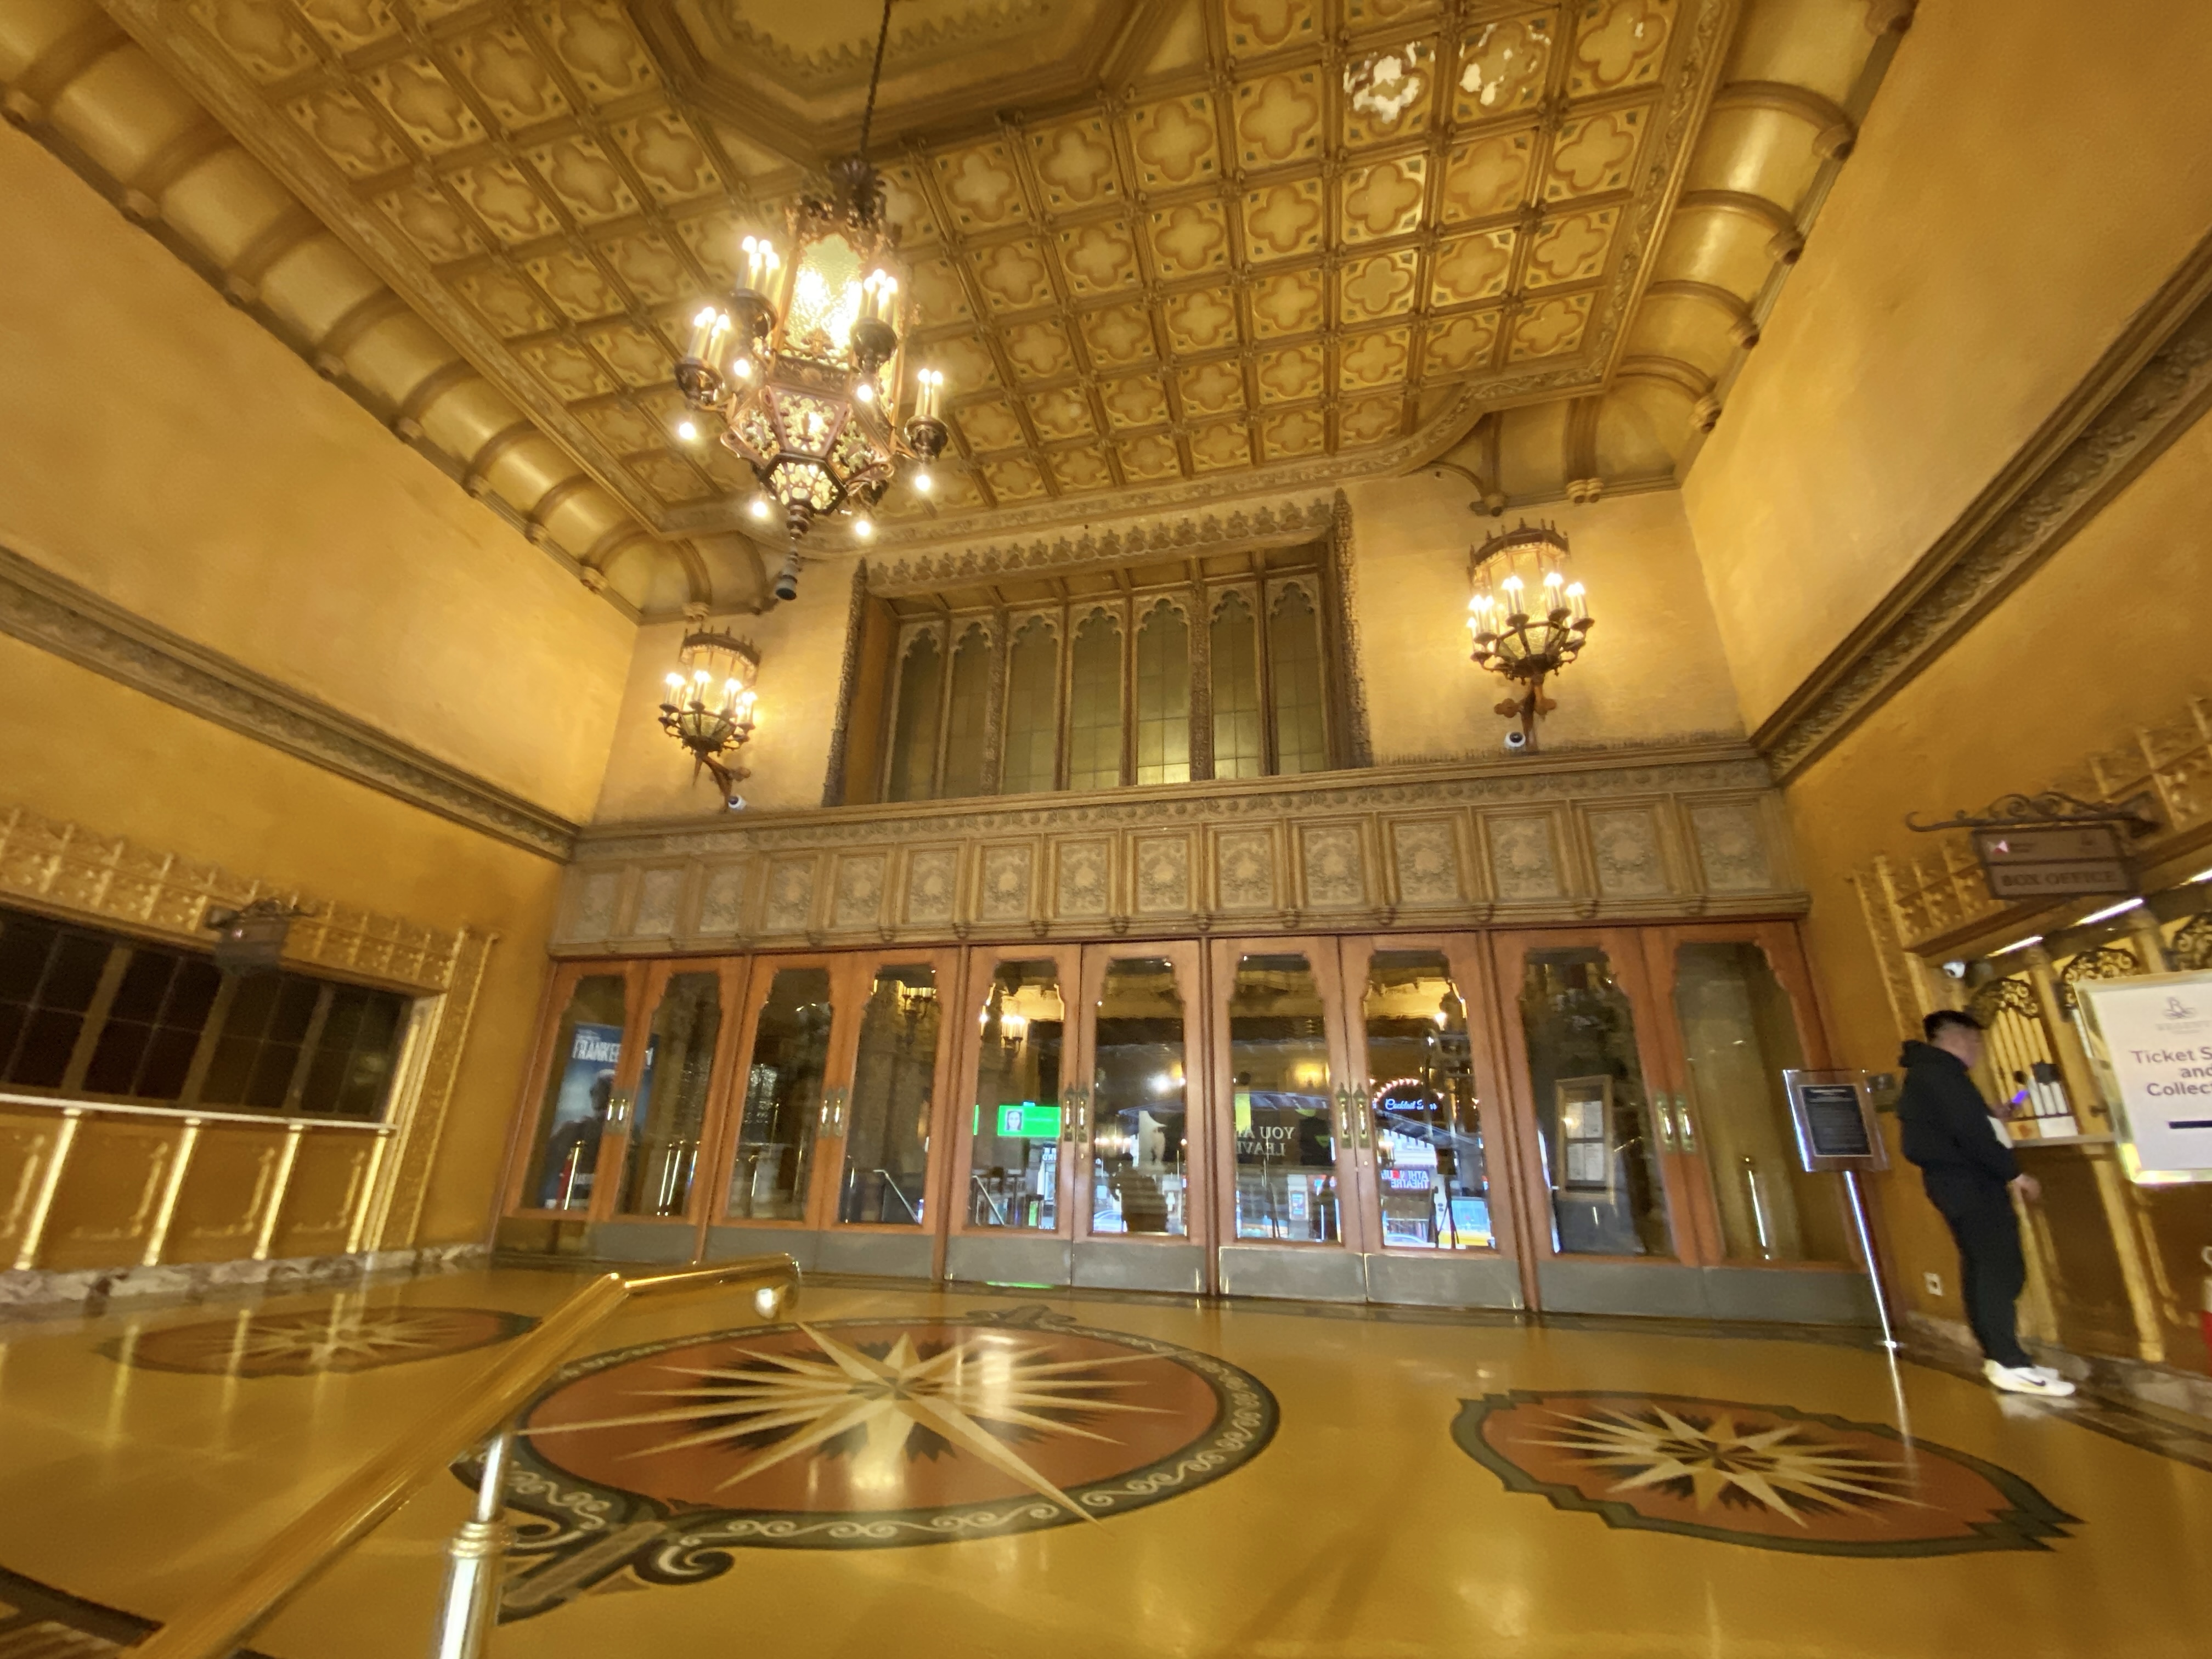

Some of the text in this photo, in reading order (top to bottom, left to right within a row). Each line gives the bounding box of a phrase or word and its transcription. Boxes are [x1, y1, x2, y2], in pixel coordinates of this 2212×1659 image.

[2130, 1046, 2212, 1064] Ticket S
[2146, 1081, 2212, 1096] Collec
